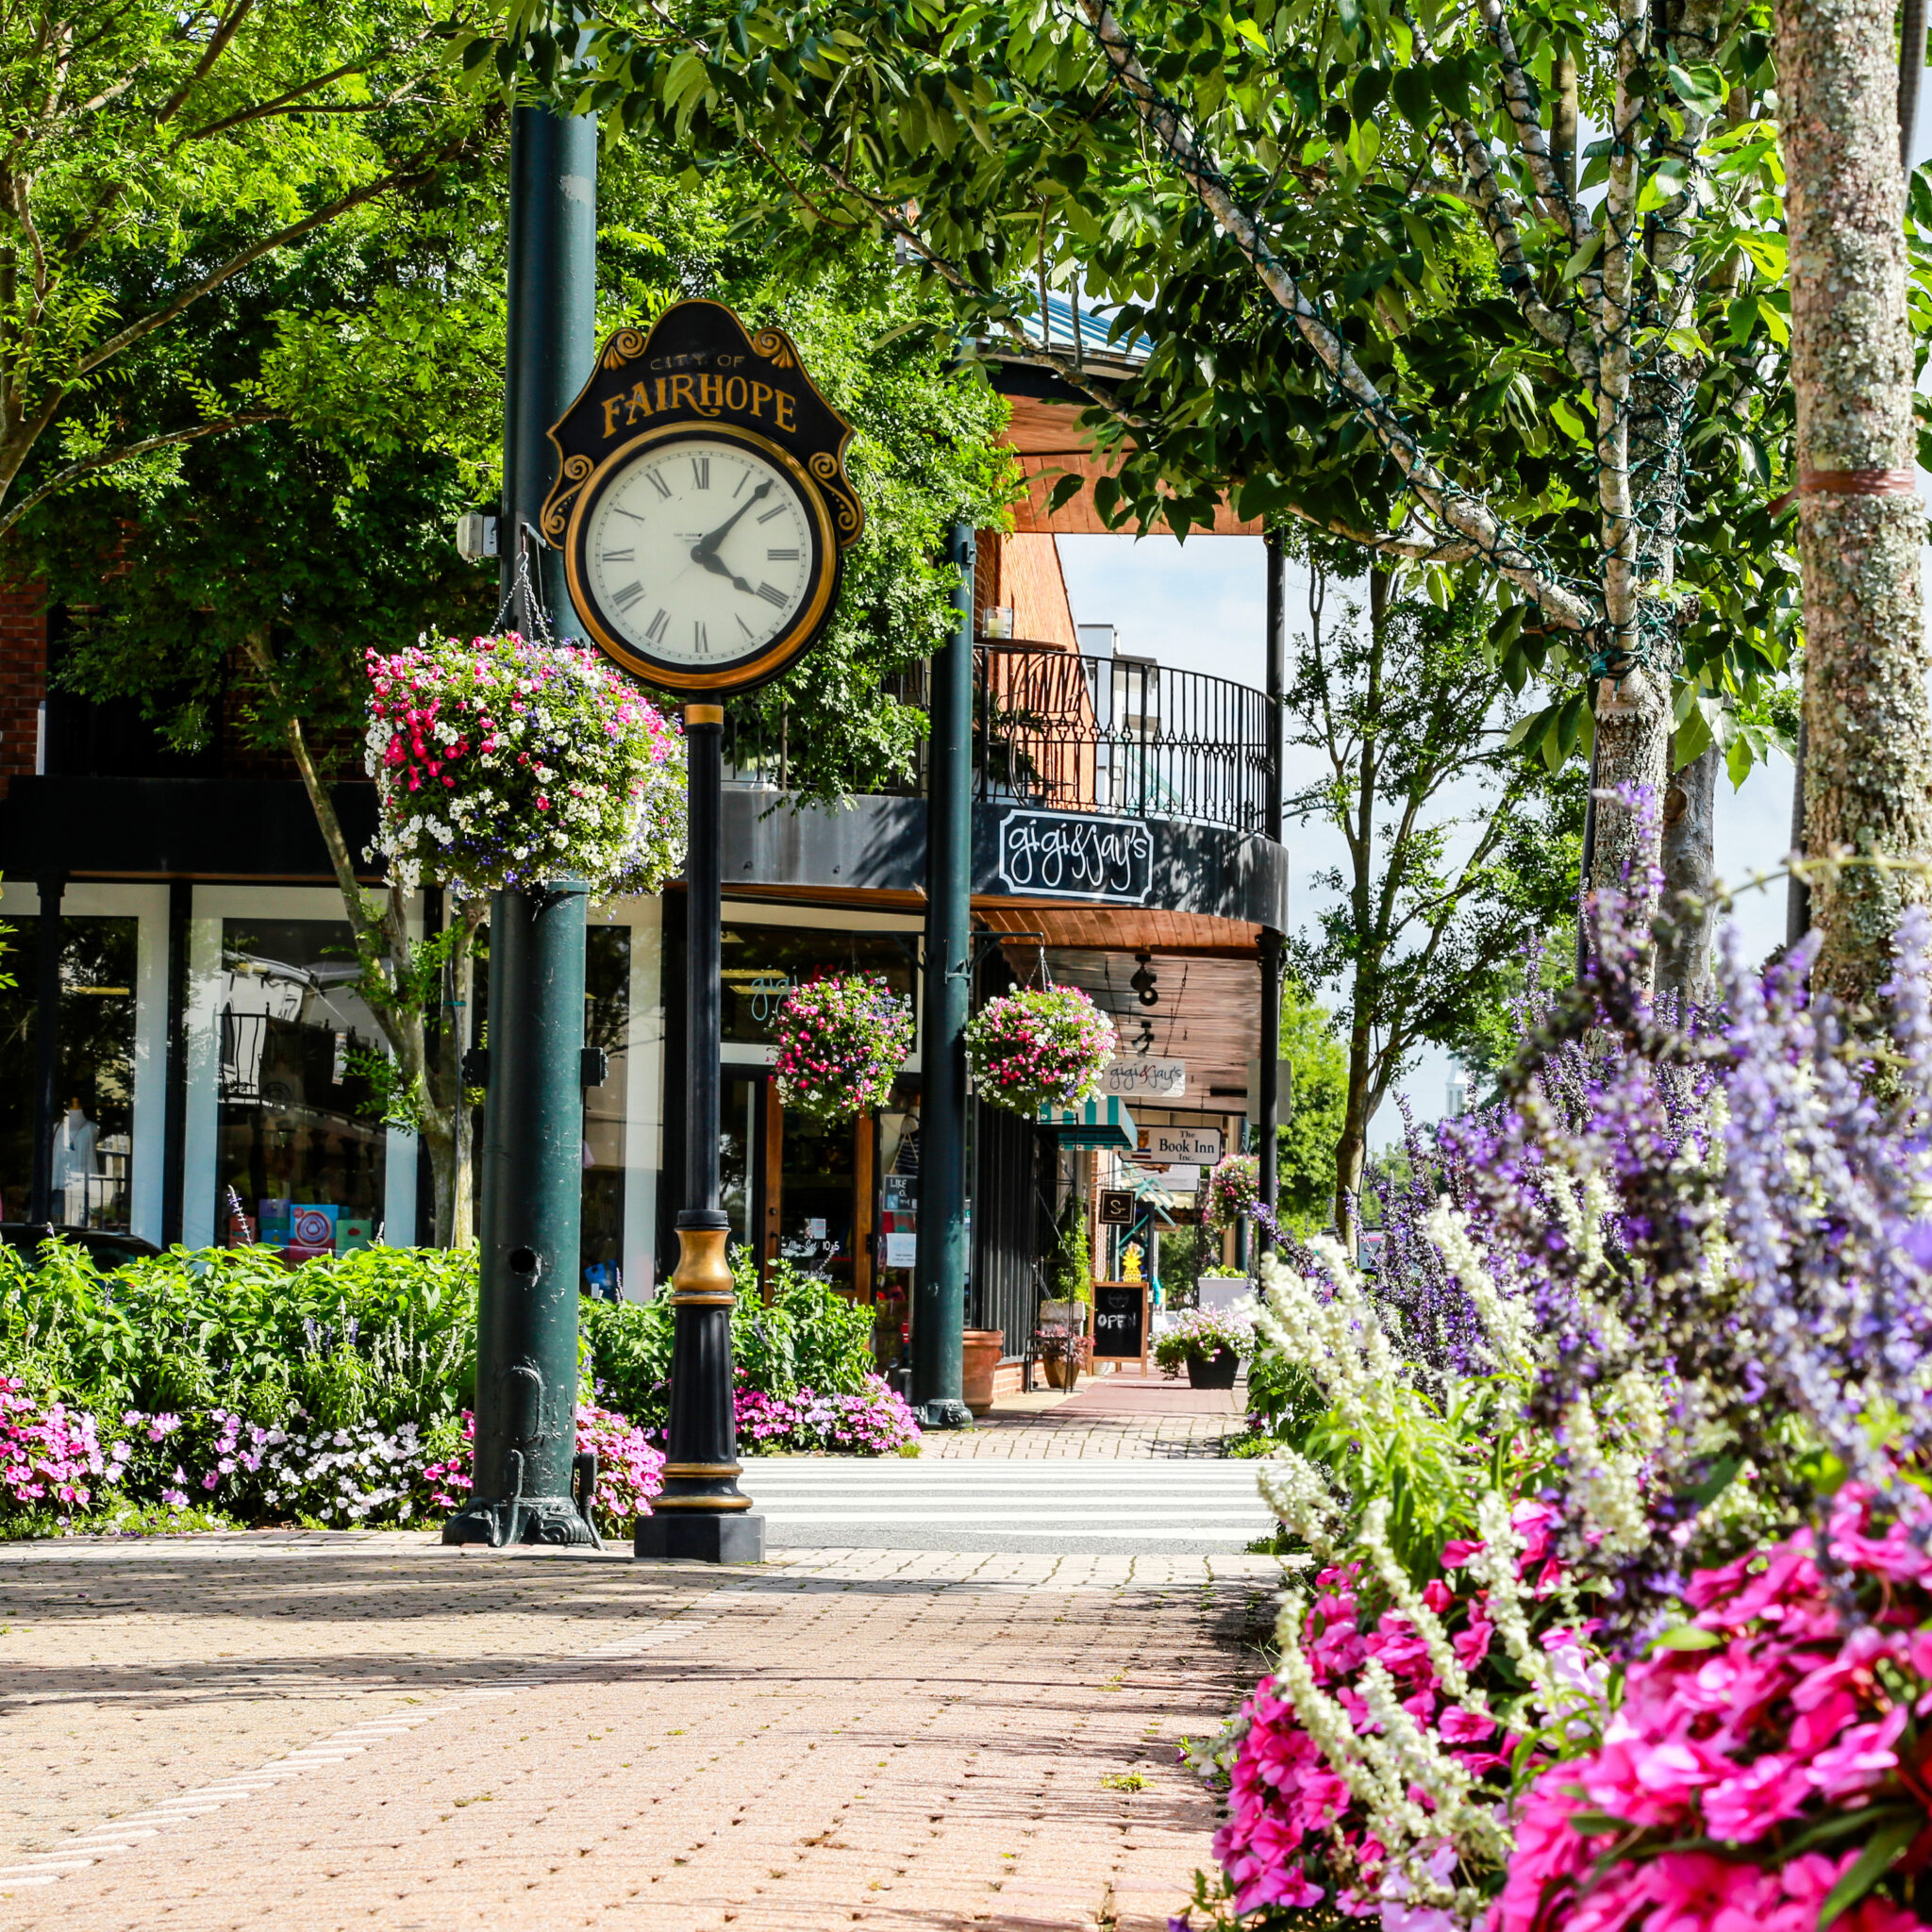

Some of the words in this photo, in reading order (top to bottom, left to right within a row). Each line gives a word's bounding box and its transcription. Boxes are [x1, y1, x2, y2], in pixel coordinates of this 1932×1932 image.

[651, 354, 705, 371] CITY
[717, 354, 745, 368] OF
[602, 374, 796, 439] FAIRHOPE
[691, 458, 709, 490] XII
[767, 549, 799, 560] III
[1180, 1130, 1196, 1139] The
[1159, 1138, 1190, 1153] Book
[1194, 1140, 1215, 1154] Inn
[1178, 1153, 1195, 1161] Inc.
[890, 1178, 908, 1190] LIKE
